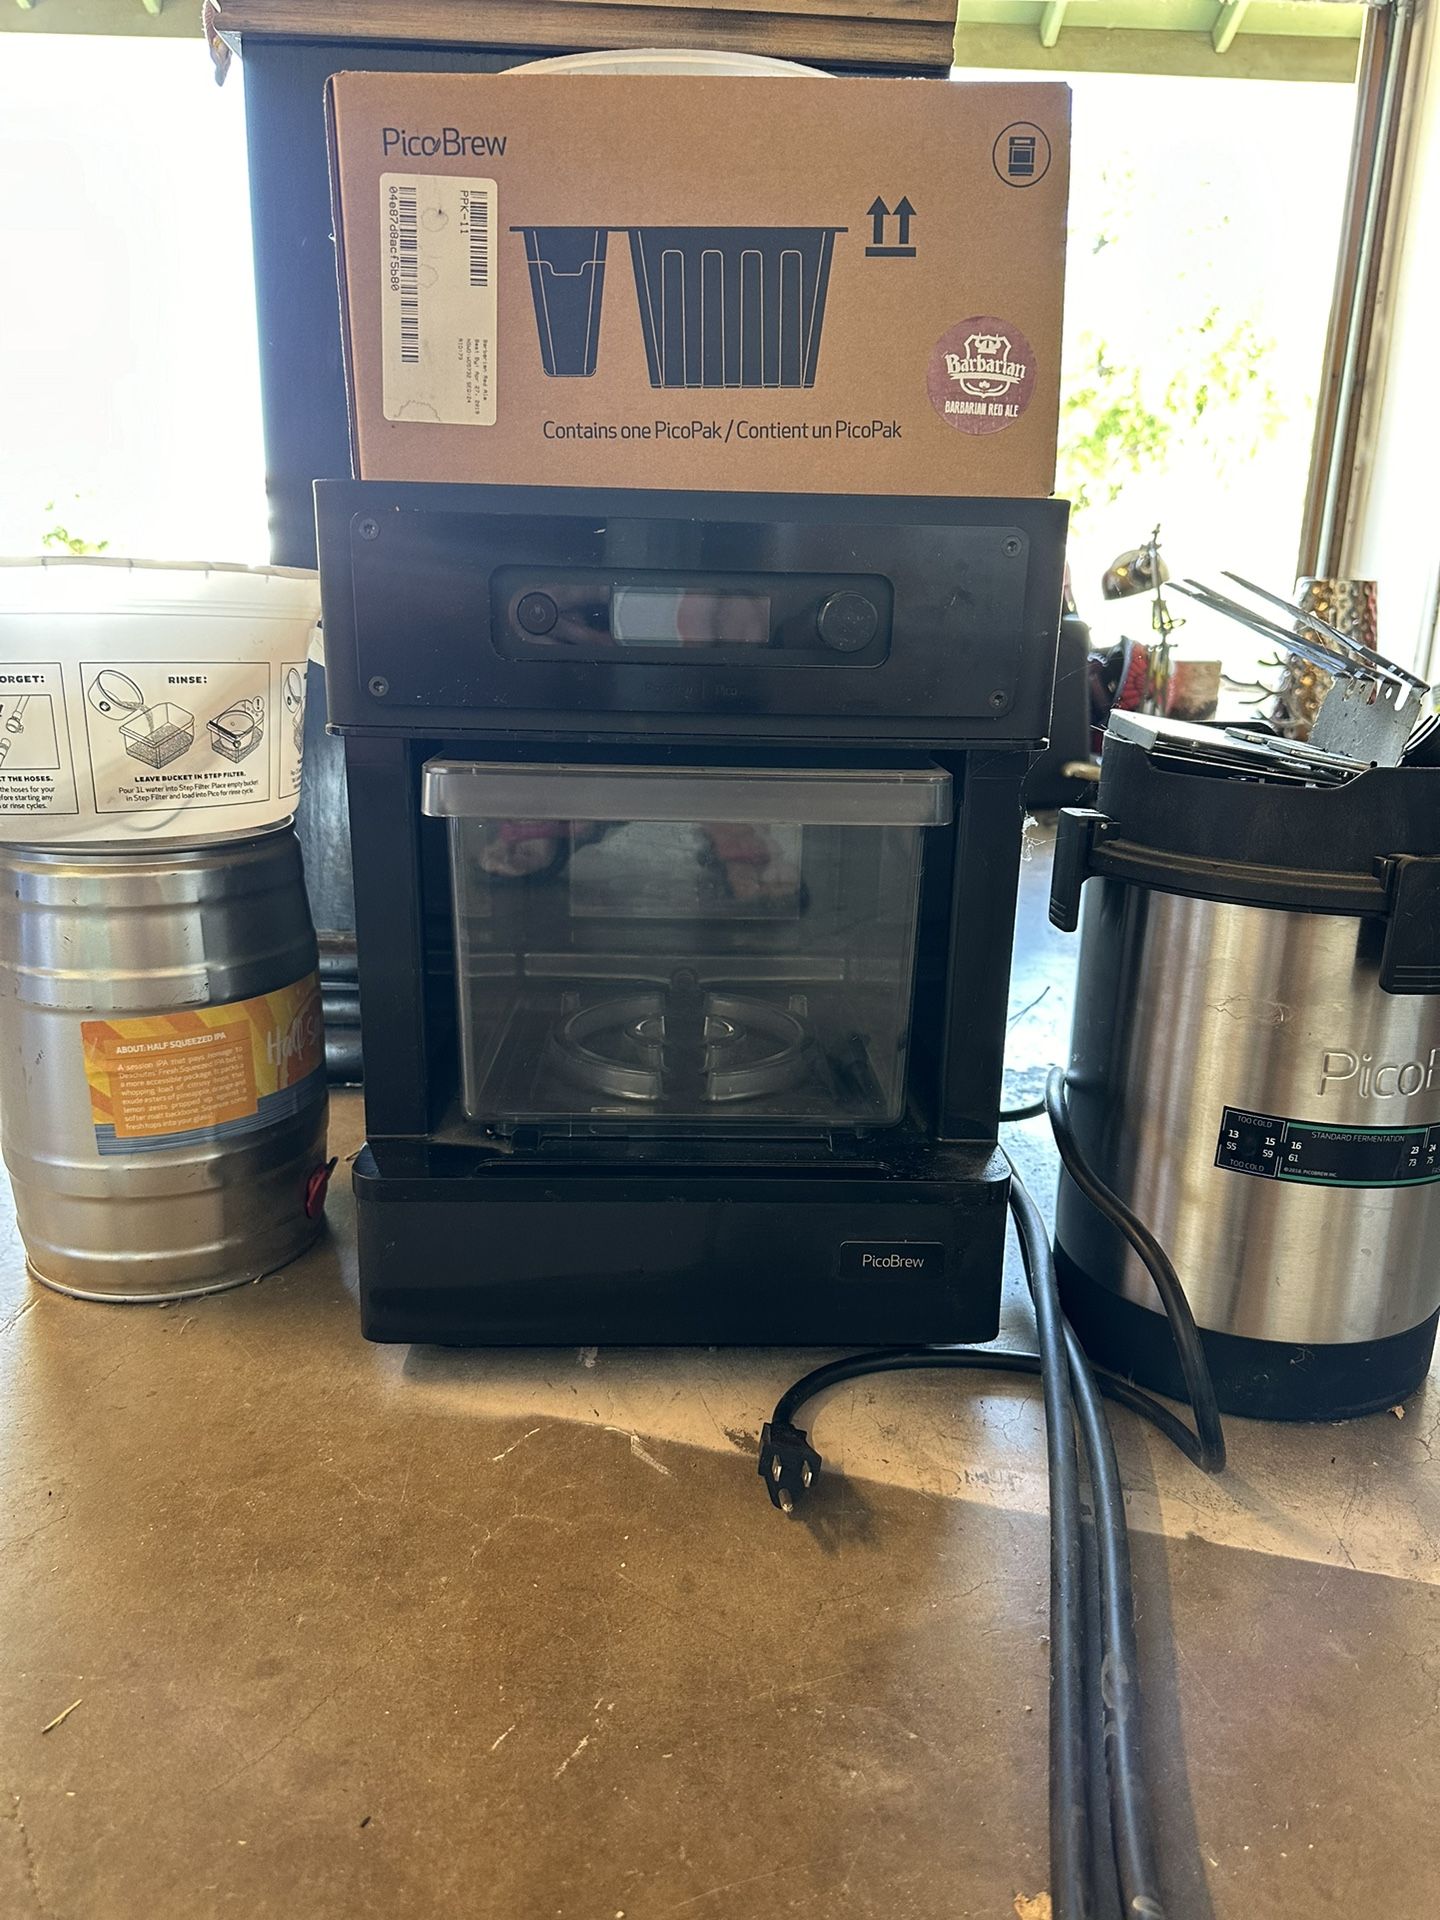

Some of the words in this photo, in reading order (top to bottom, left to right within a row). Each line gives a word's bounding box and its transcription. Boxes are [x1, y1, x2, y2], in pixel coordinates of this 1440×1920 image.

[382, 127, 507, 156] PicoBrew
[460, 190, 469, 234] PPK-11
[944, 353, 1026, 379] Barbarian
[944, 400, 986, 416] BARBARIAN
[988, 402, 1004, 416] RED
[1004, 404, 1019, 418] ALE
[543, 420, 617, 439] Contains
[620, 425, 651, 439] one
[655, 420, 722, 439] PicoPak
[736, 420, 808, 439] Contient
[812, 425, 832, 439] un
[835, 420, 902, 439] PicoPak
[168, 676, 208, 684] RINSE:
[116, 1044, 147, 1054] ABOUT:
[147, 1040, 168, 1051] HALF
[170, 1035, 213, 1048] SQUEEZED
[214, 1032, 226, 1040] IPA
[1238, 1115, 1251, 1124] TOO
[1253, 1119, 1273, 1128] COLD
[1228, 1129, 1239, 1138] 13
[1265, 1137, 1276, 1146] 15
[1291, 1141, 1302, 1149] 16
[1411, 1146, 1419, 1154] 23
[1429, 1144, 1436, 1152] 24
[1312, 1131, 1352, 1142] STANDARD
[1226, 1142, 1237, 1150] 55
[1262, 1149, 1273, 1158] 59
[1288, 1153, 1298, 1162] 61
[1408, 1158, 1417, 1167] 73
[1426, 1156, 1434, 1164] 75
[1230, 1158, 1243, 1167] TOO
[1245, 1162, 1264, 1172] COLD
[862, 1254, 924, 1268] PicoBrew
